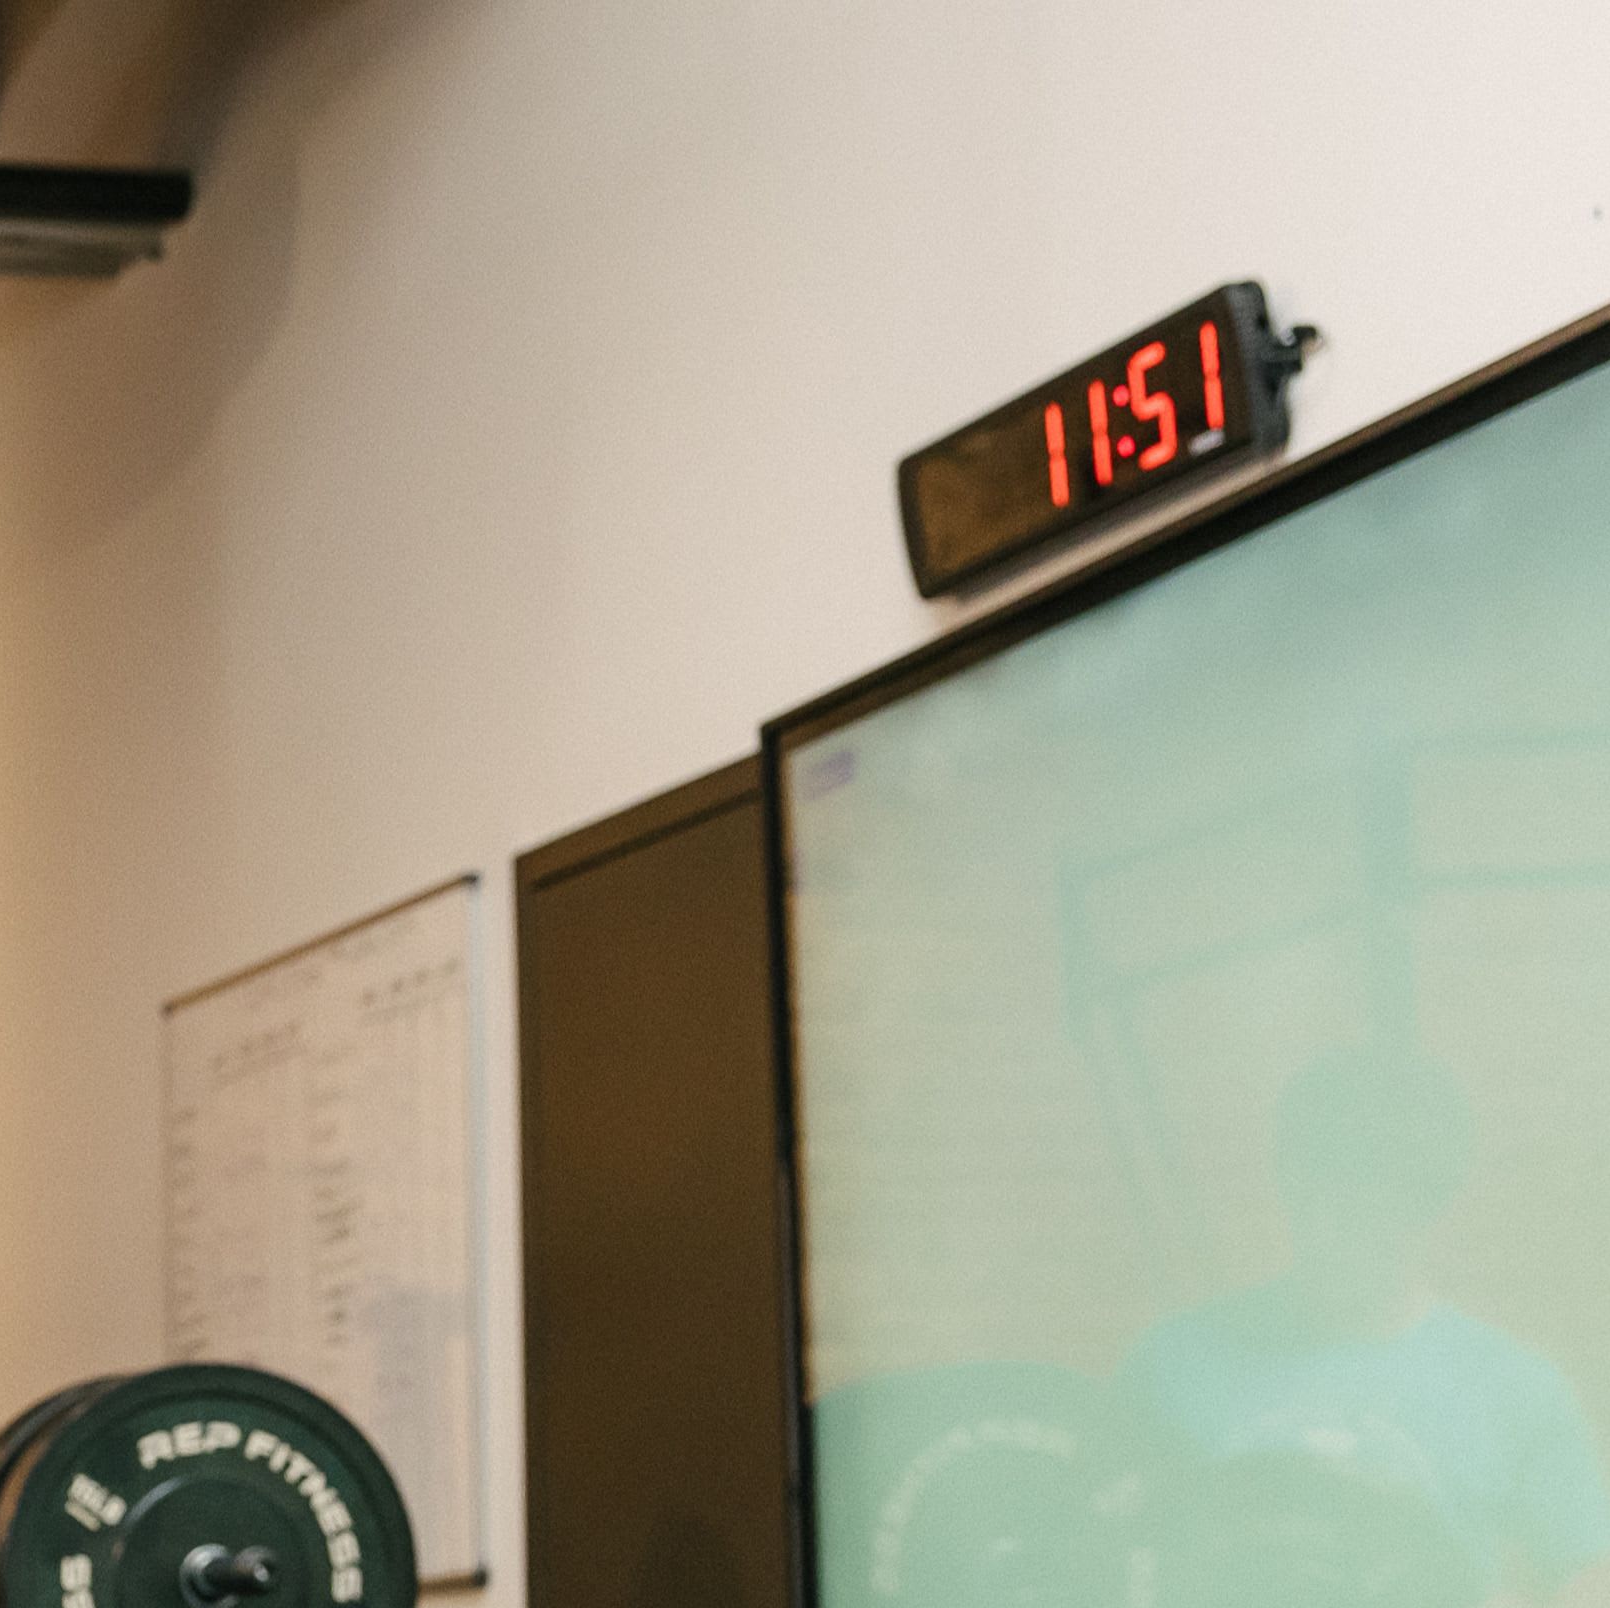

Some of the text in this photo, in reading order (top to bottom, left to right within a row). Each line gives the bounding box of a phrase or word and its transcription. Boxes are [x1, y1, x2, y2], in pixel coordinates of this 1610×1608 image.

[1044, 321, 1224, 507] 11:51
[136, 1419, 243, 1471] REP
[244, 1429, 364, 1603] FITNESS
